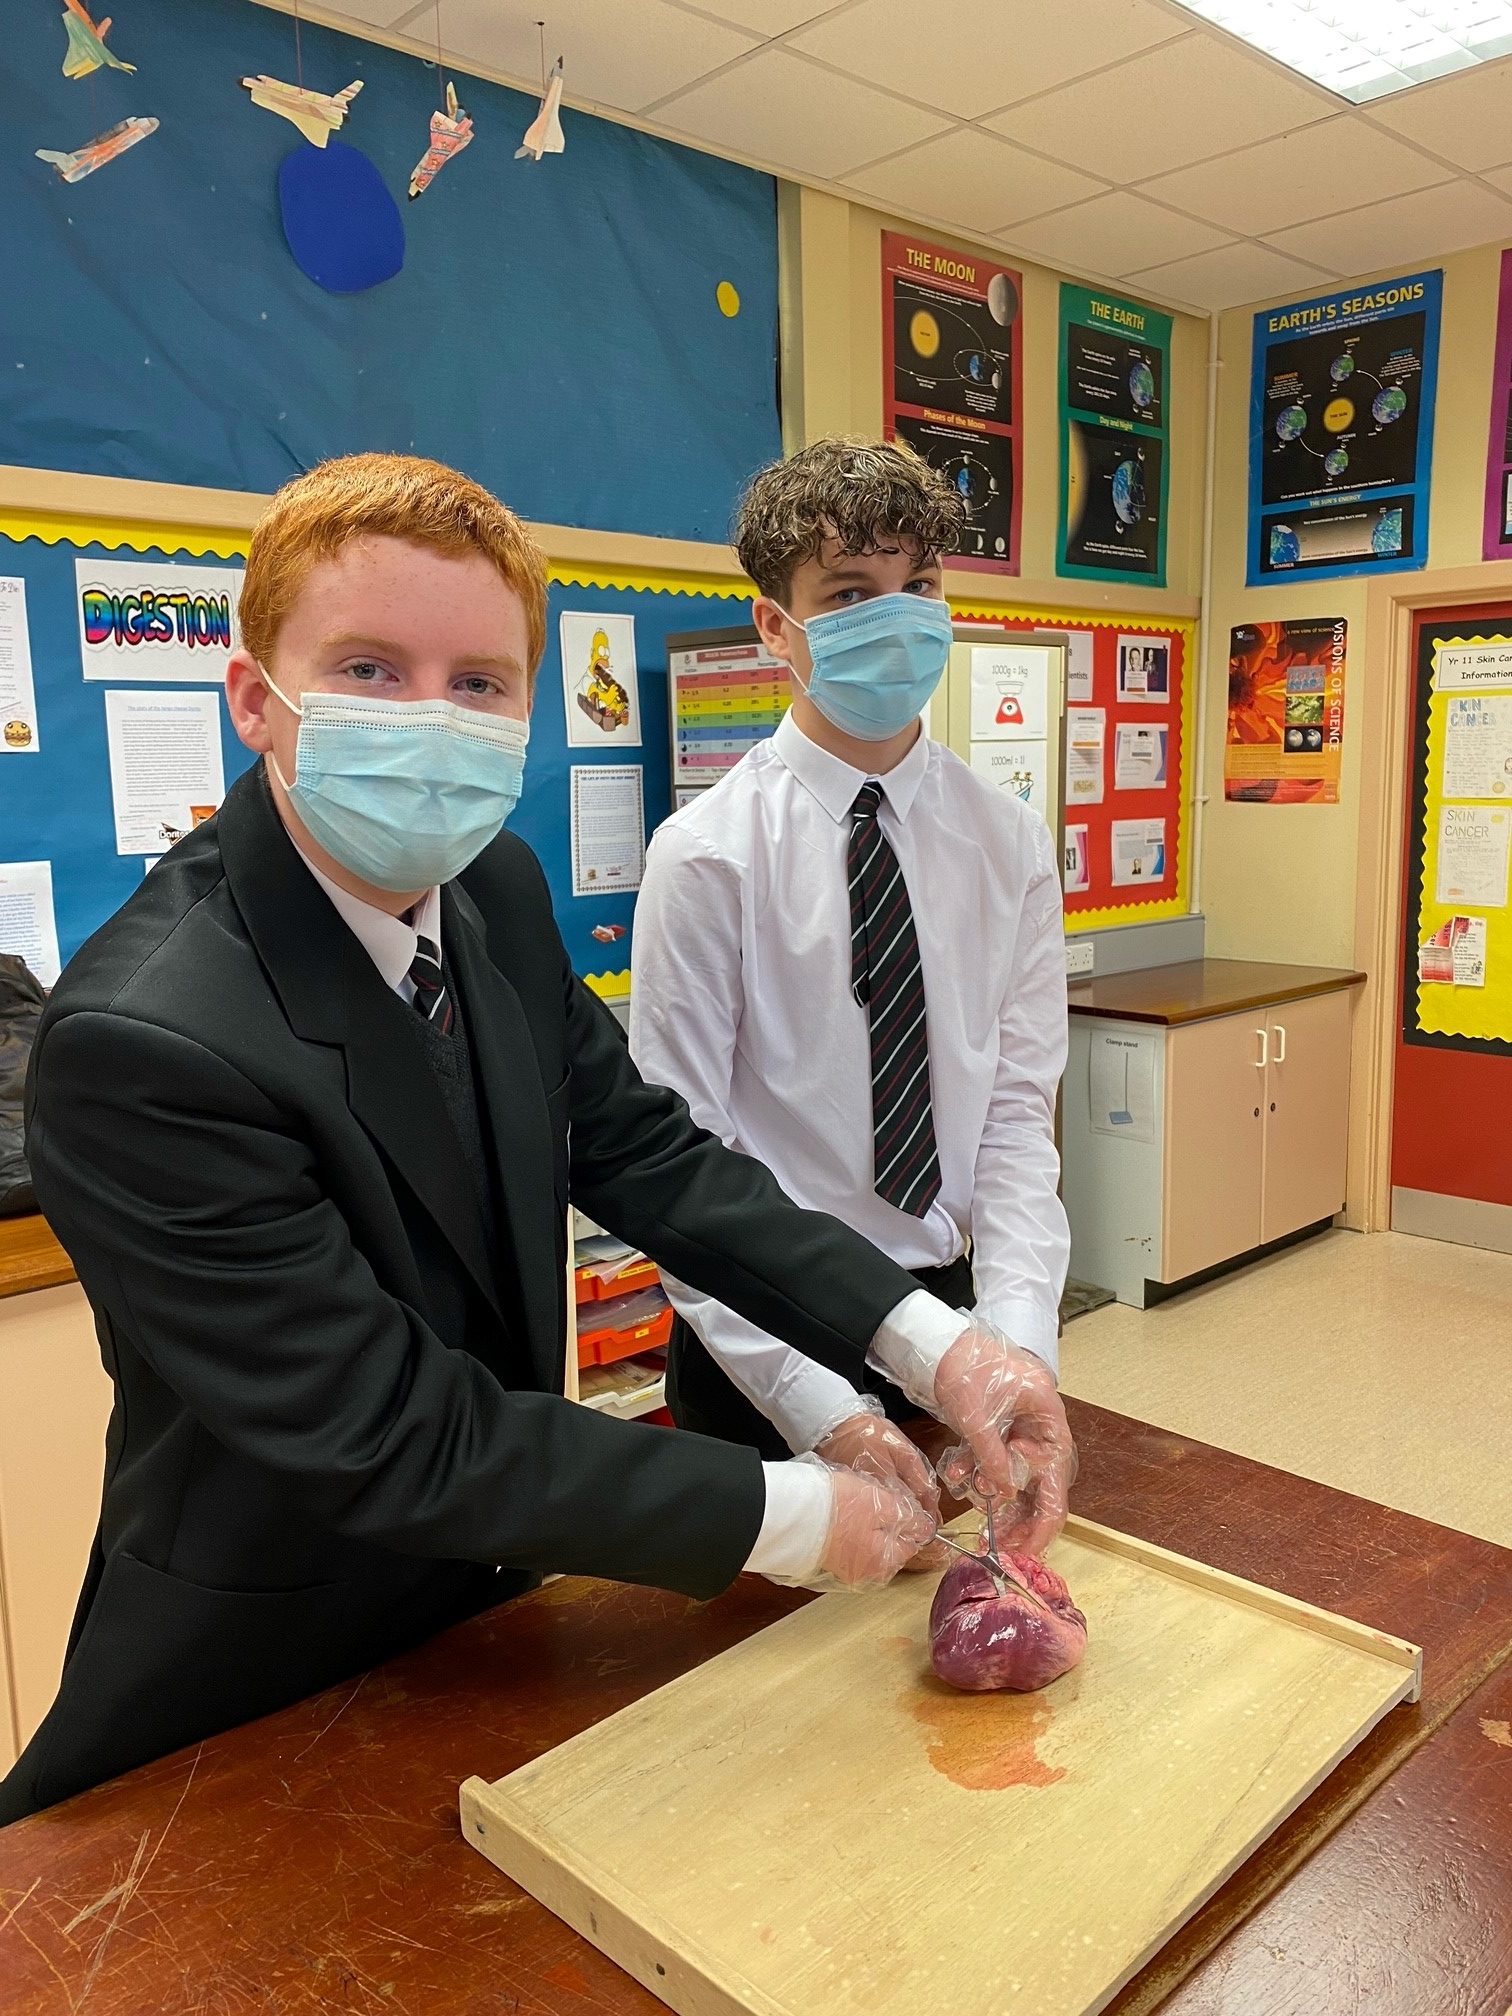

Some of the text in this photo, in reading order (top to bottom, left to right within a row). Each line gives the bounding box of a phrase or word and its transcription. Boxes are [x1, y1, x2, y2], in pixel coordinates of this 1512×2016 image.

[906, 248, 931, 270] THE
[934, 257, 975, 283] MOON
[1268, 283, 1424, 333] EARTH'S SEASONS
[1090, 300, 1111, 320] THE
[1113, 307, 1145, 331] EARTH
[923, 408, 986, 430] Phases of the Moon
[82, 589, 231, 649] DIGESTION
[1448, 657, 1459, 665] Yr
[1463, 656, 1472, 664] 11
[1476, 655, 1495, 664] Skin
[992, 665, 1011, 678] 1000g
[1018, 665, 1028, 678] 1kg
[1069, 671, 1088, 680] ientists
[1461, 670, 1512, 679] Information
[1329, 621, 1344, 752] VISIONS OF SCIENCE
[991, 756, 1013, 766] 1000ml
[1447, 809, 1475, 822] SKIN
[1444, 825, 1489, 838] CANCER
[1105, 1038, 1123, 1047] Clamp
